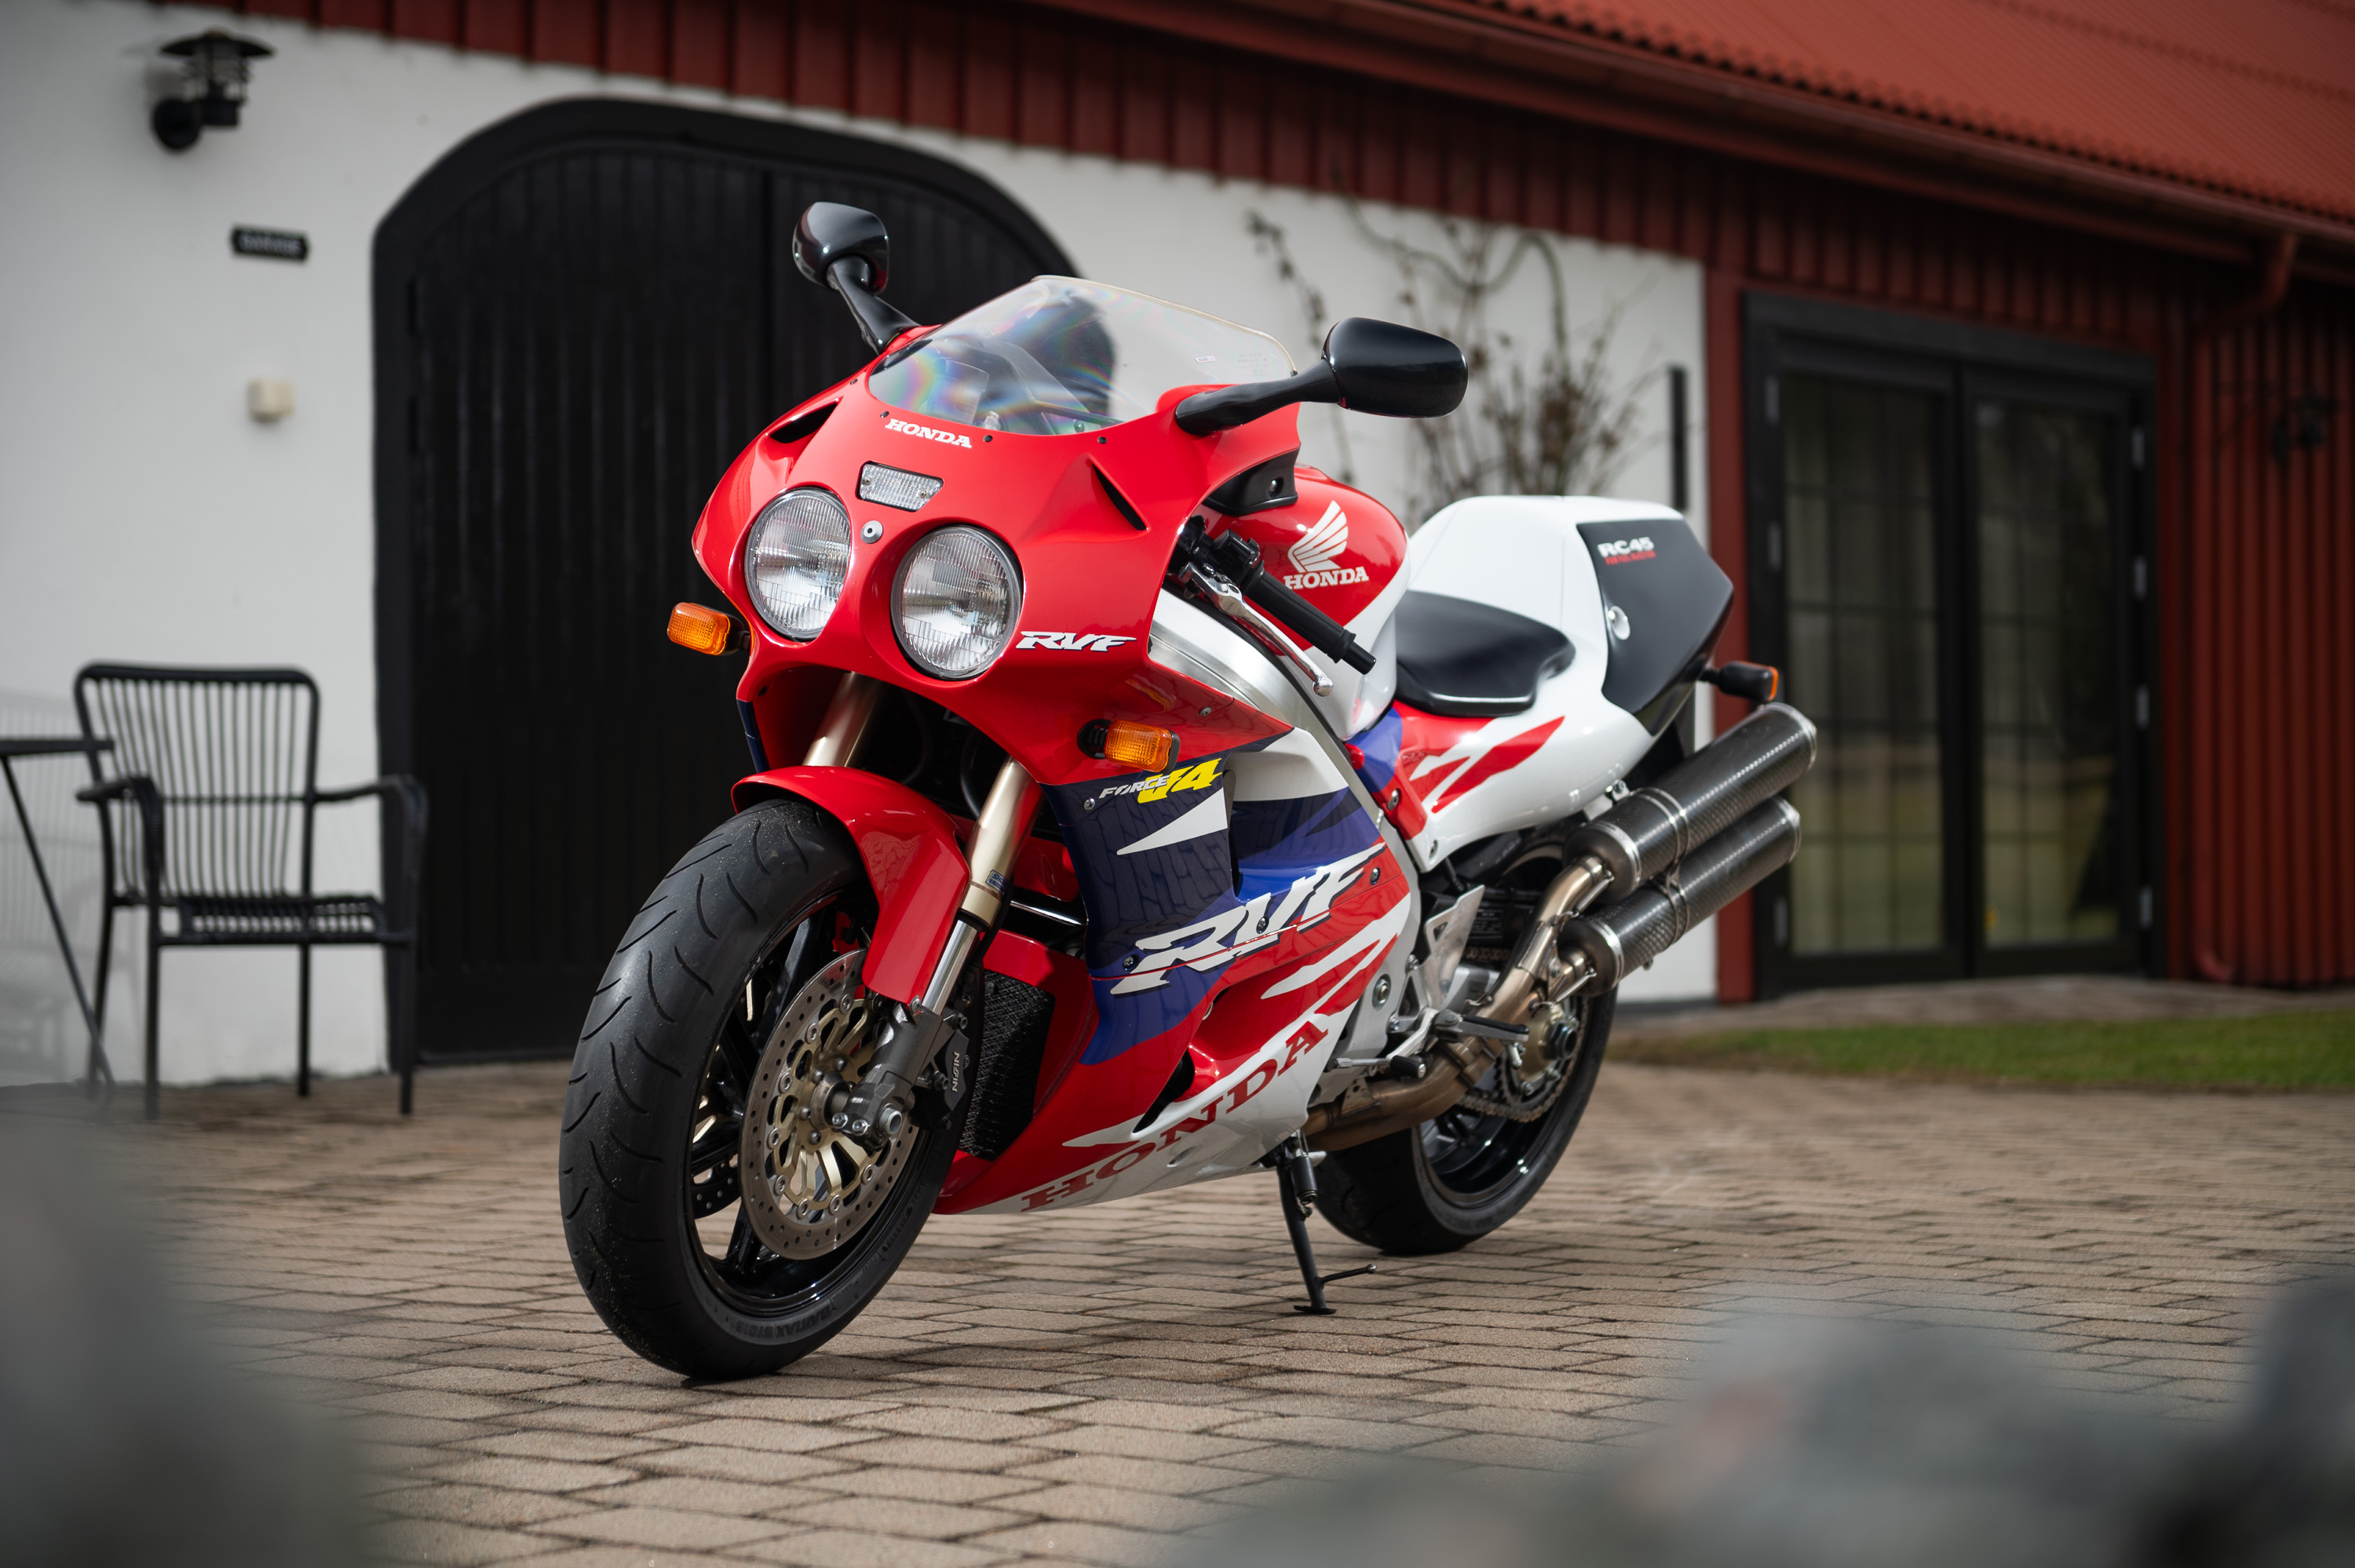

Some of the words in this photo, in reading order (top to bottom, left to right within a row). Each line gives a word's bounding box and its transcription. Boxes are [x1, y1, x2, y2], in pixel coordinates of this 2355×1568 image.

[885, 418, 973, 449] HONDA
[1597, 537, 1654, 557] RC45
[1283, 566, 1369, 590] HONDA
[1016, 630, 1137, 652] RVF
[1099, 775, 1170, 799] FORCE
[1137, 757, 1222, 804] V4
[1111, 841, 1387, 995] RVF
[951, 1051, 960, 1092] NISSIN
[1020, 1020, 1328, 1212] HONDA
